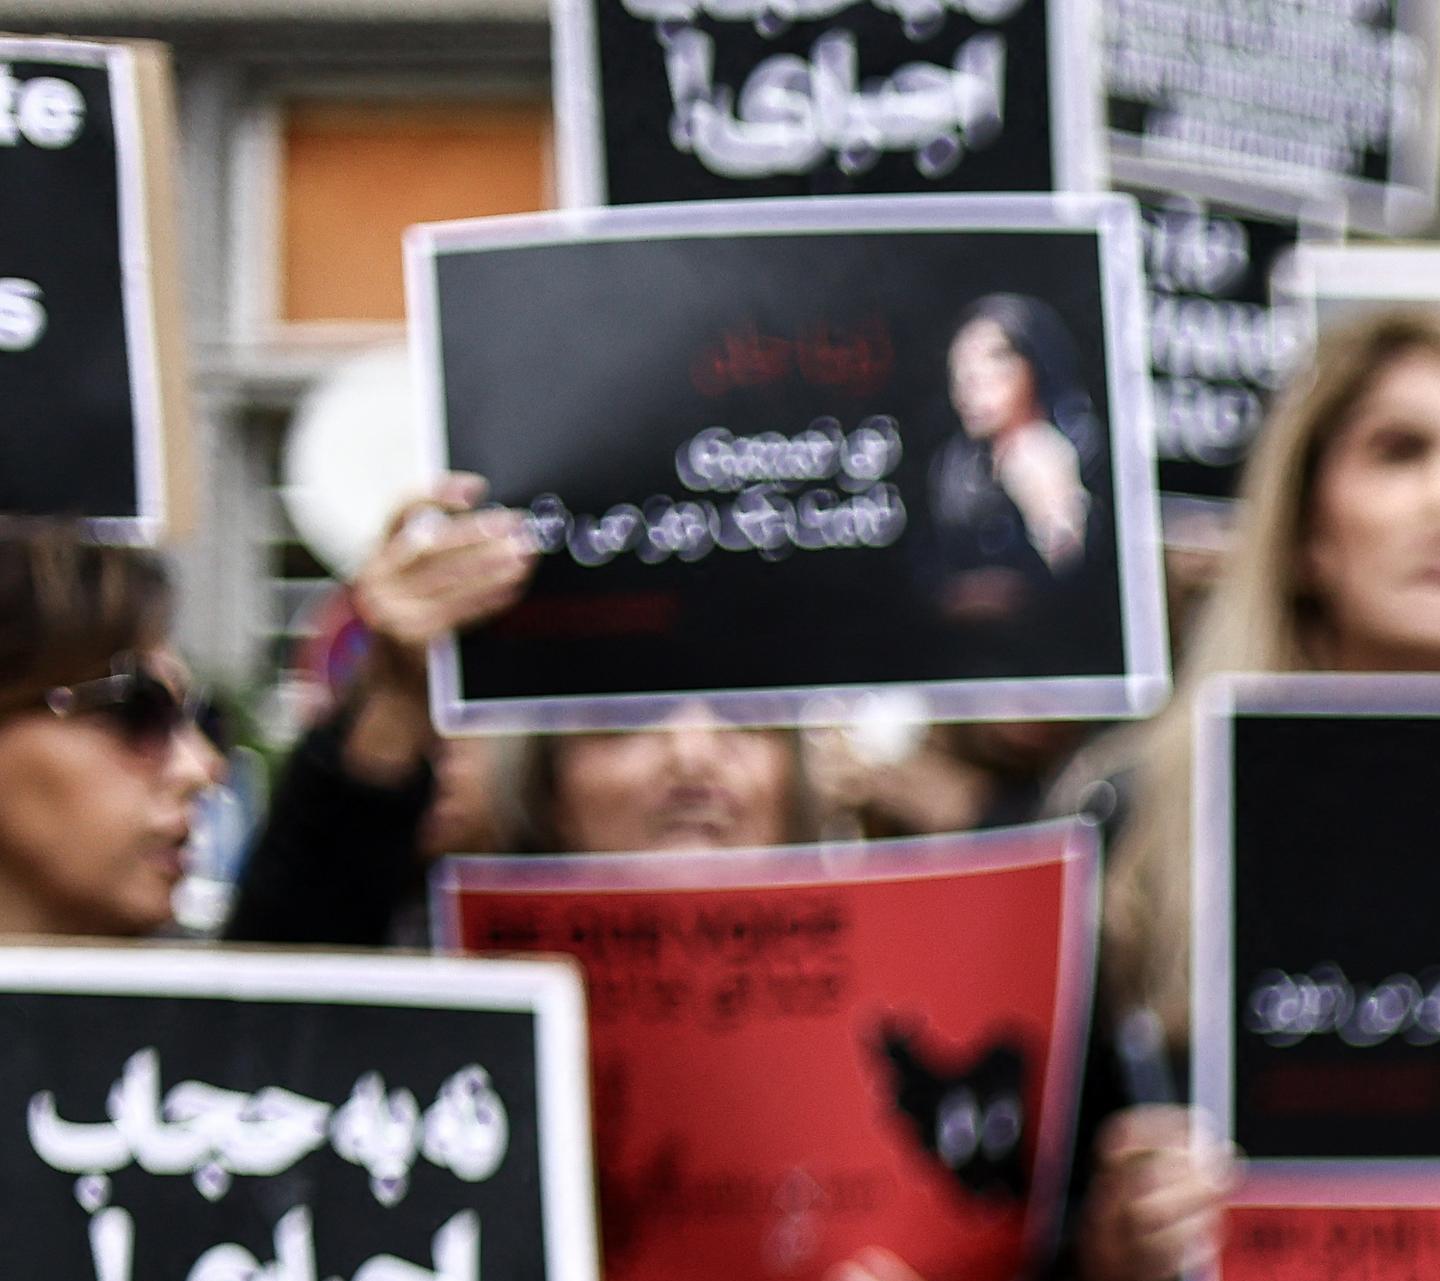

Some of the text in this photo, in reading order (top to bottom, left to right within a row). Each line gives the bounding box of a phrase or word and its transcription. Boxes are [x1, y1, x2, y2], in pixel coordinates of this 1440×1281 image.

[26, 1046, 510, 1212] نه به حجاب
